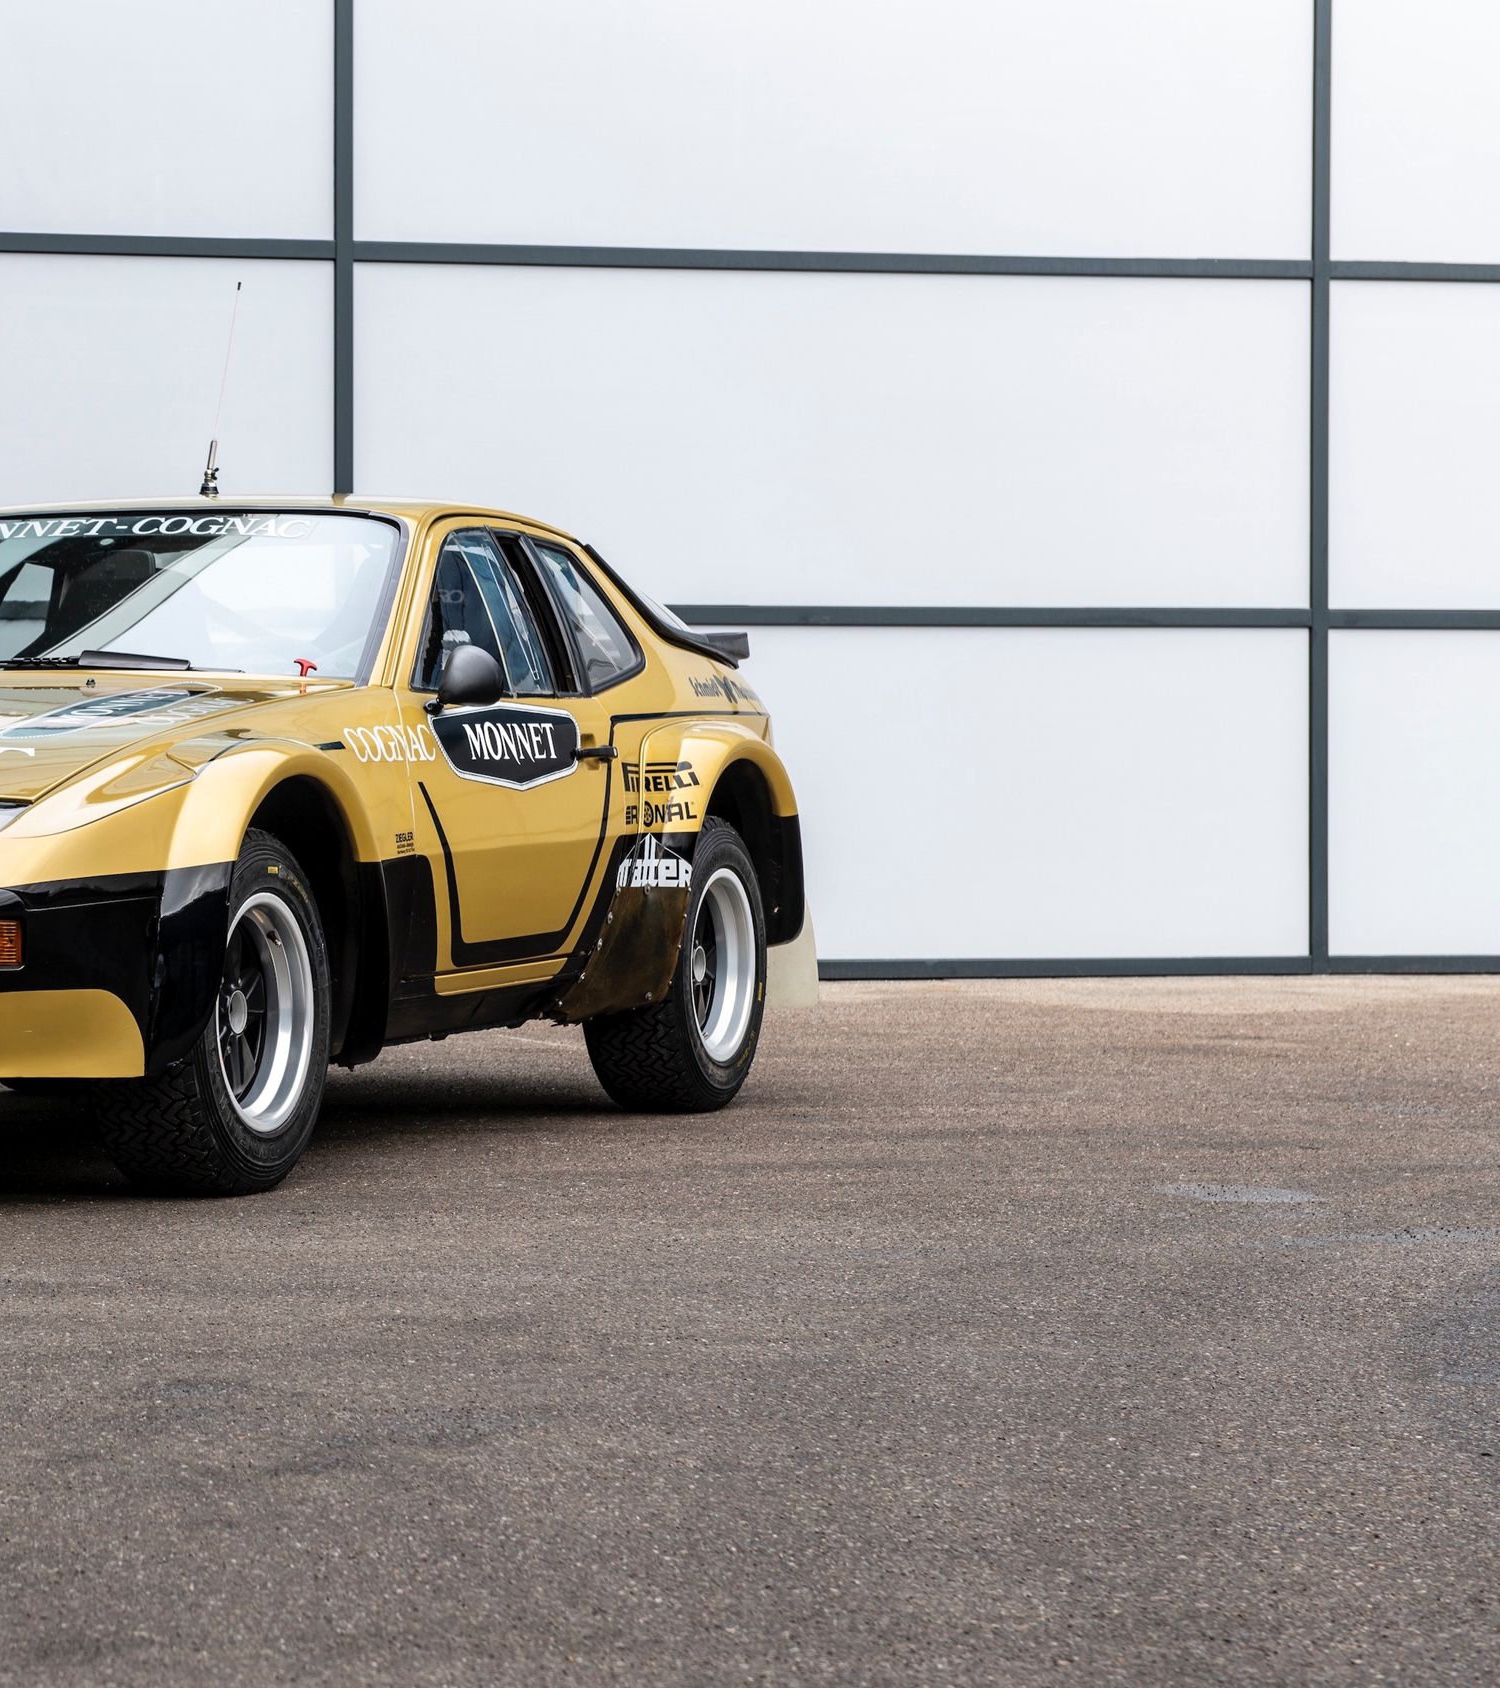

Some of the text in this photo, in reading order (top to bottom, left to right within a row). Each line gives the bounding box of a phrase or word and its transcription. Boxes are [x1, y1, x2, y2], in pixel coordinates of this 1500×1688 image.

[343, 724, 436, 763] COGNAC
[462, 721, 556, 766] MONNET
[622, 761, 700, 792] PIRELLI
